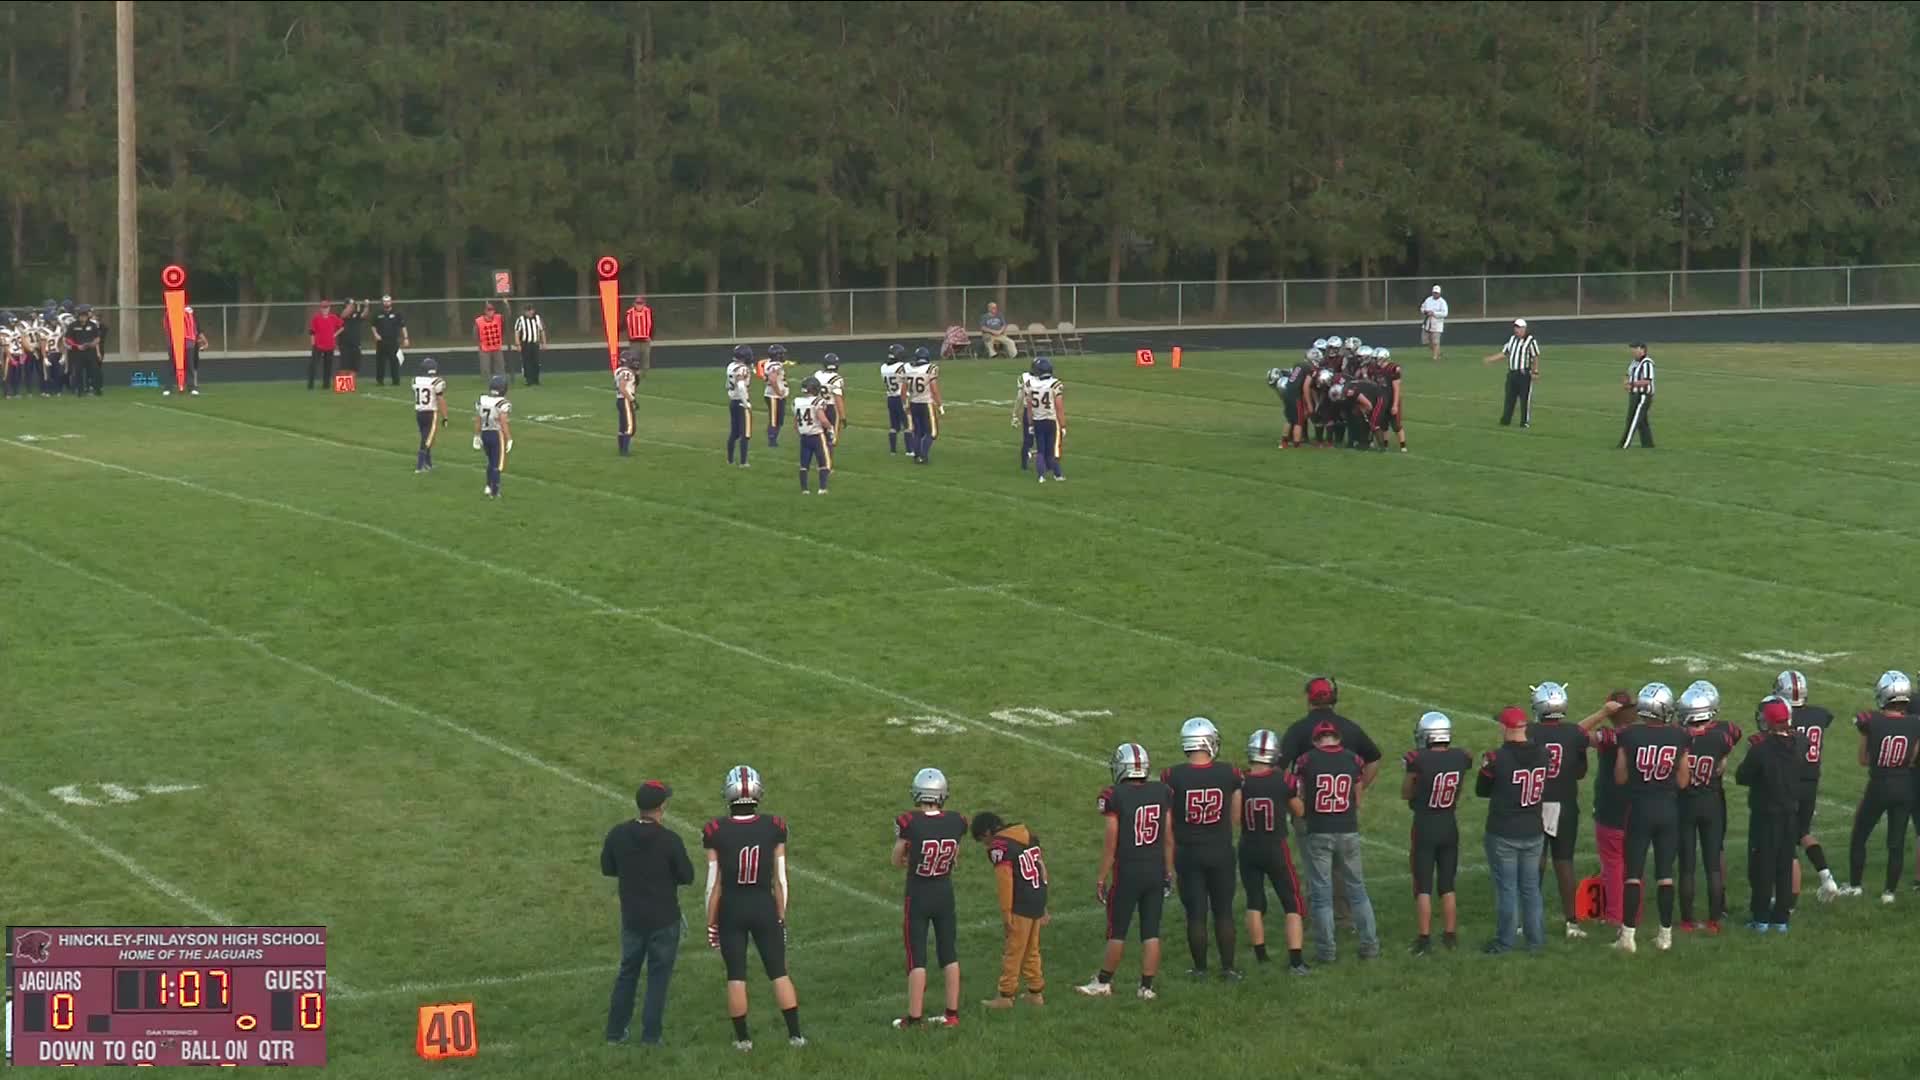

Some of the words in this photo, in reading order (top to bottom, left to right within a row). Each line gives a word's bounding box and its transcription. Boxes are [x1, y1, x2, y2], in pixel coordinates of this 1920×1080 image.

[1140, 351, 1152, 363] G
[416, 388, 431, 405] 13
[907, 377, 925, 393] 76
[1031, 391, 1051, 409] 54
[482, 408, 491, 427] 7
[796, 408, 813, 426] 44
[1636, 745, 1677, 781] 46
[1878, 735, 1908, 767] 10
[1315, 774, 1352, 813] 29
[1429, 771, 1459, 808] 16
[1512, 768, 1546, 807] 76
[1185, 788, 1223, 824] 52
[1245, 798, 1274, 831] 17
[1134, 804, 1161, 846] 15
[737, 845, 759, 884] 11
[916, 839, 957, 877] 32
[426, 1010, 472, 1054] 40
